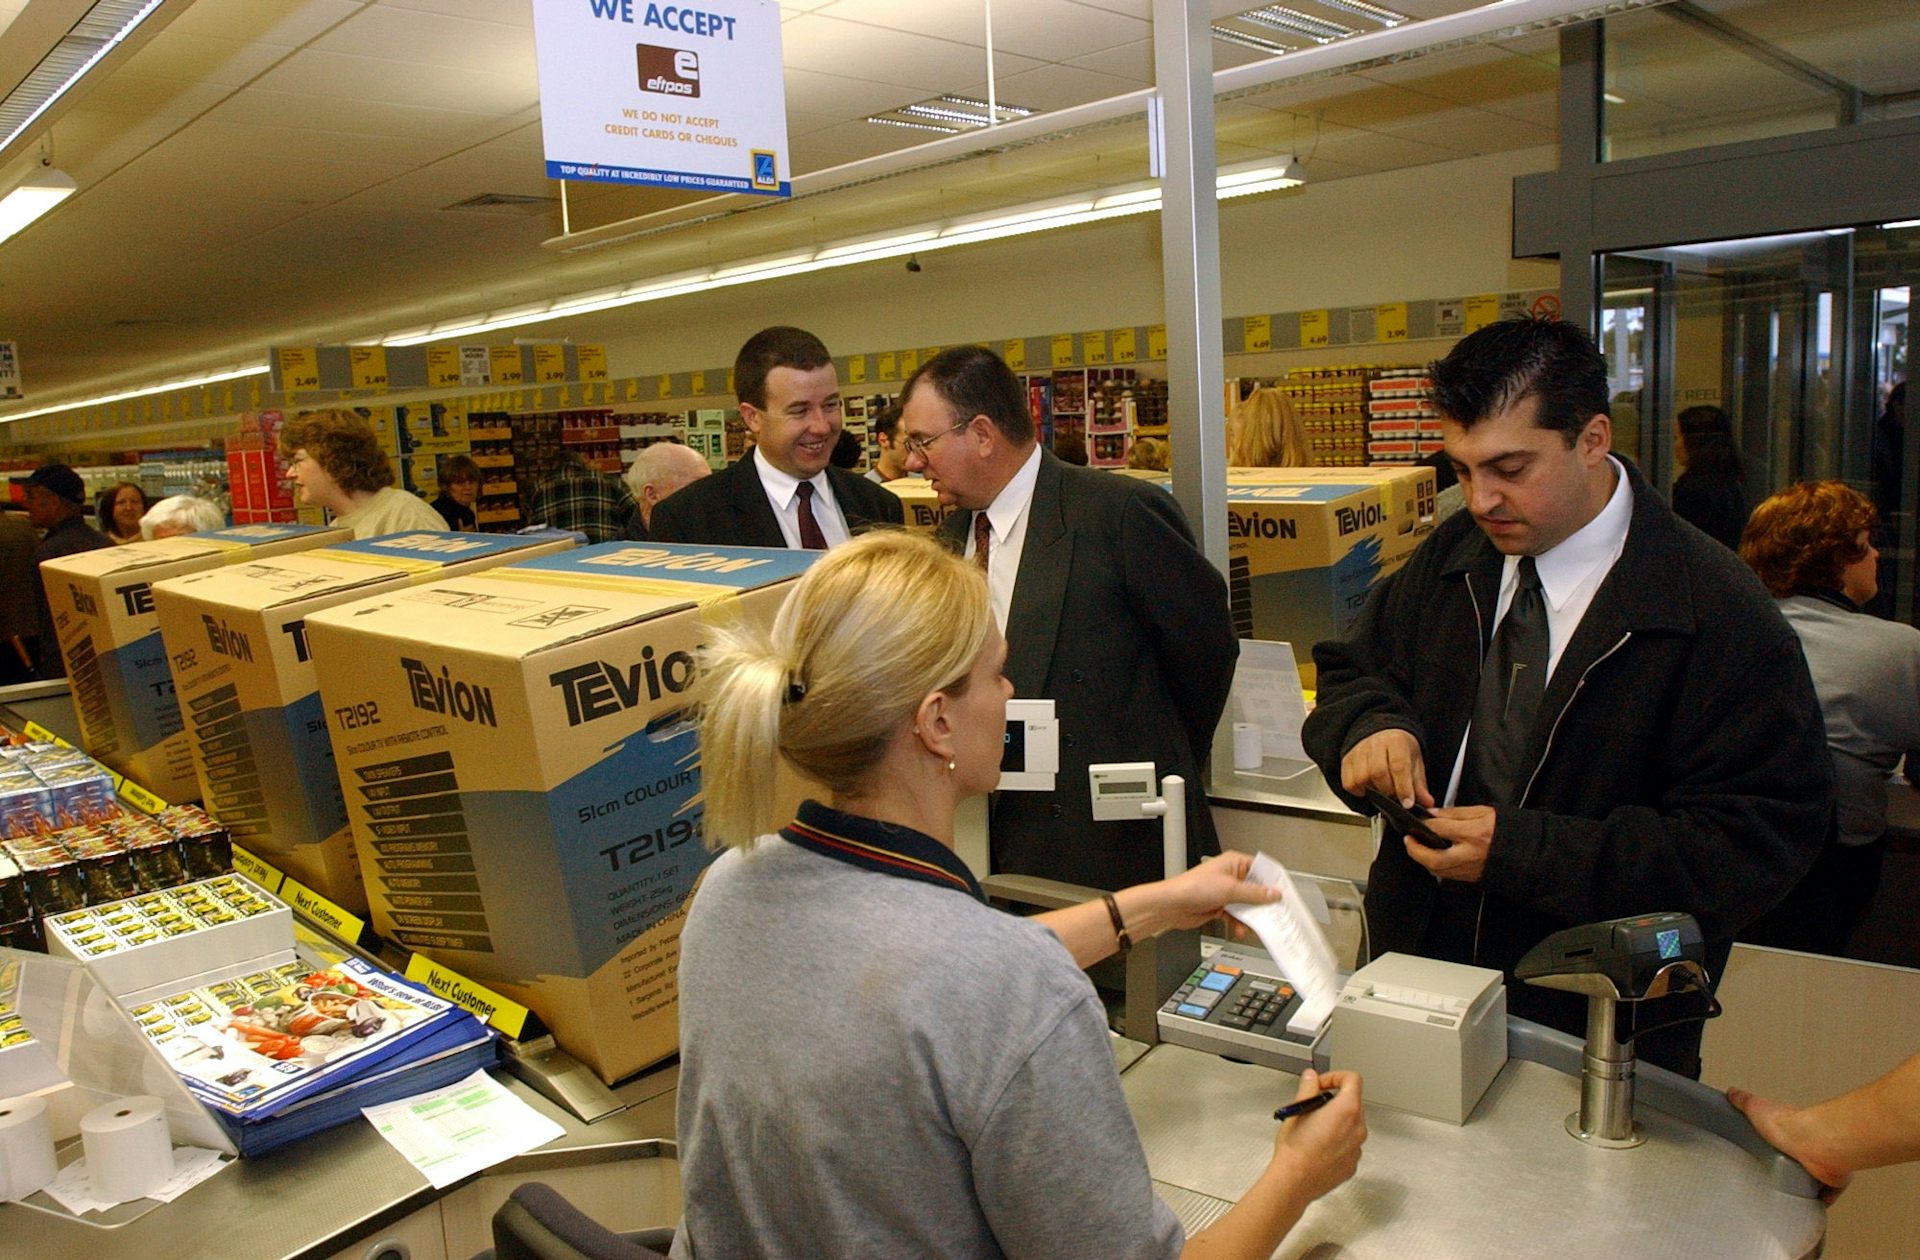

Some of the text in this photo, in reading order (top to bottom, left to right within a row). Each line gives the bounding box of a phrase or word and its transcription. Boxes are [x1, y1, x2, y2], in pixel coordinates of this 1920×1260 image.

[590, 0, 737, 41] WE ACCEPT
[646, 76, 693, 95] eftpos
[622, 108, 720, 129] WE DO NOT ACCEPT
[604, 124, 738, 148] CREDIT CARDS OR CHEQUES
[560, 164, 750, 190] TOP QUALITY AT INCREDIBLY LOW PRICES GUARANTEED
[756, 176, 776, 186] ALDI
[1228, 511, 1297, 539] EVION
[401, 656, 498, 728] TEVION
[549, 645, 706, 728] TEVIO
[335, 701, 381, 731] T2192
[578, 800, 621, 824] 51cm
[623, 770, 693, 807] COLOUR
[294, 890, 343, 930] Next Customer
[426, 969, 497, 1019] Next Customer
